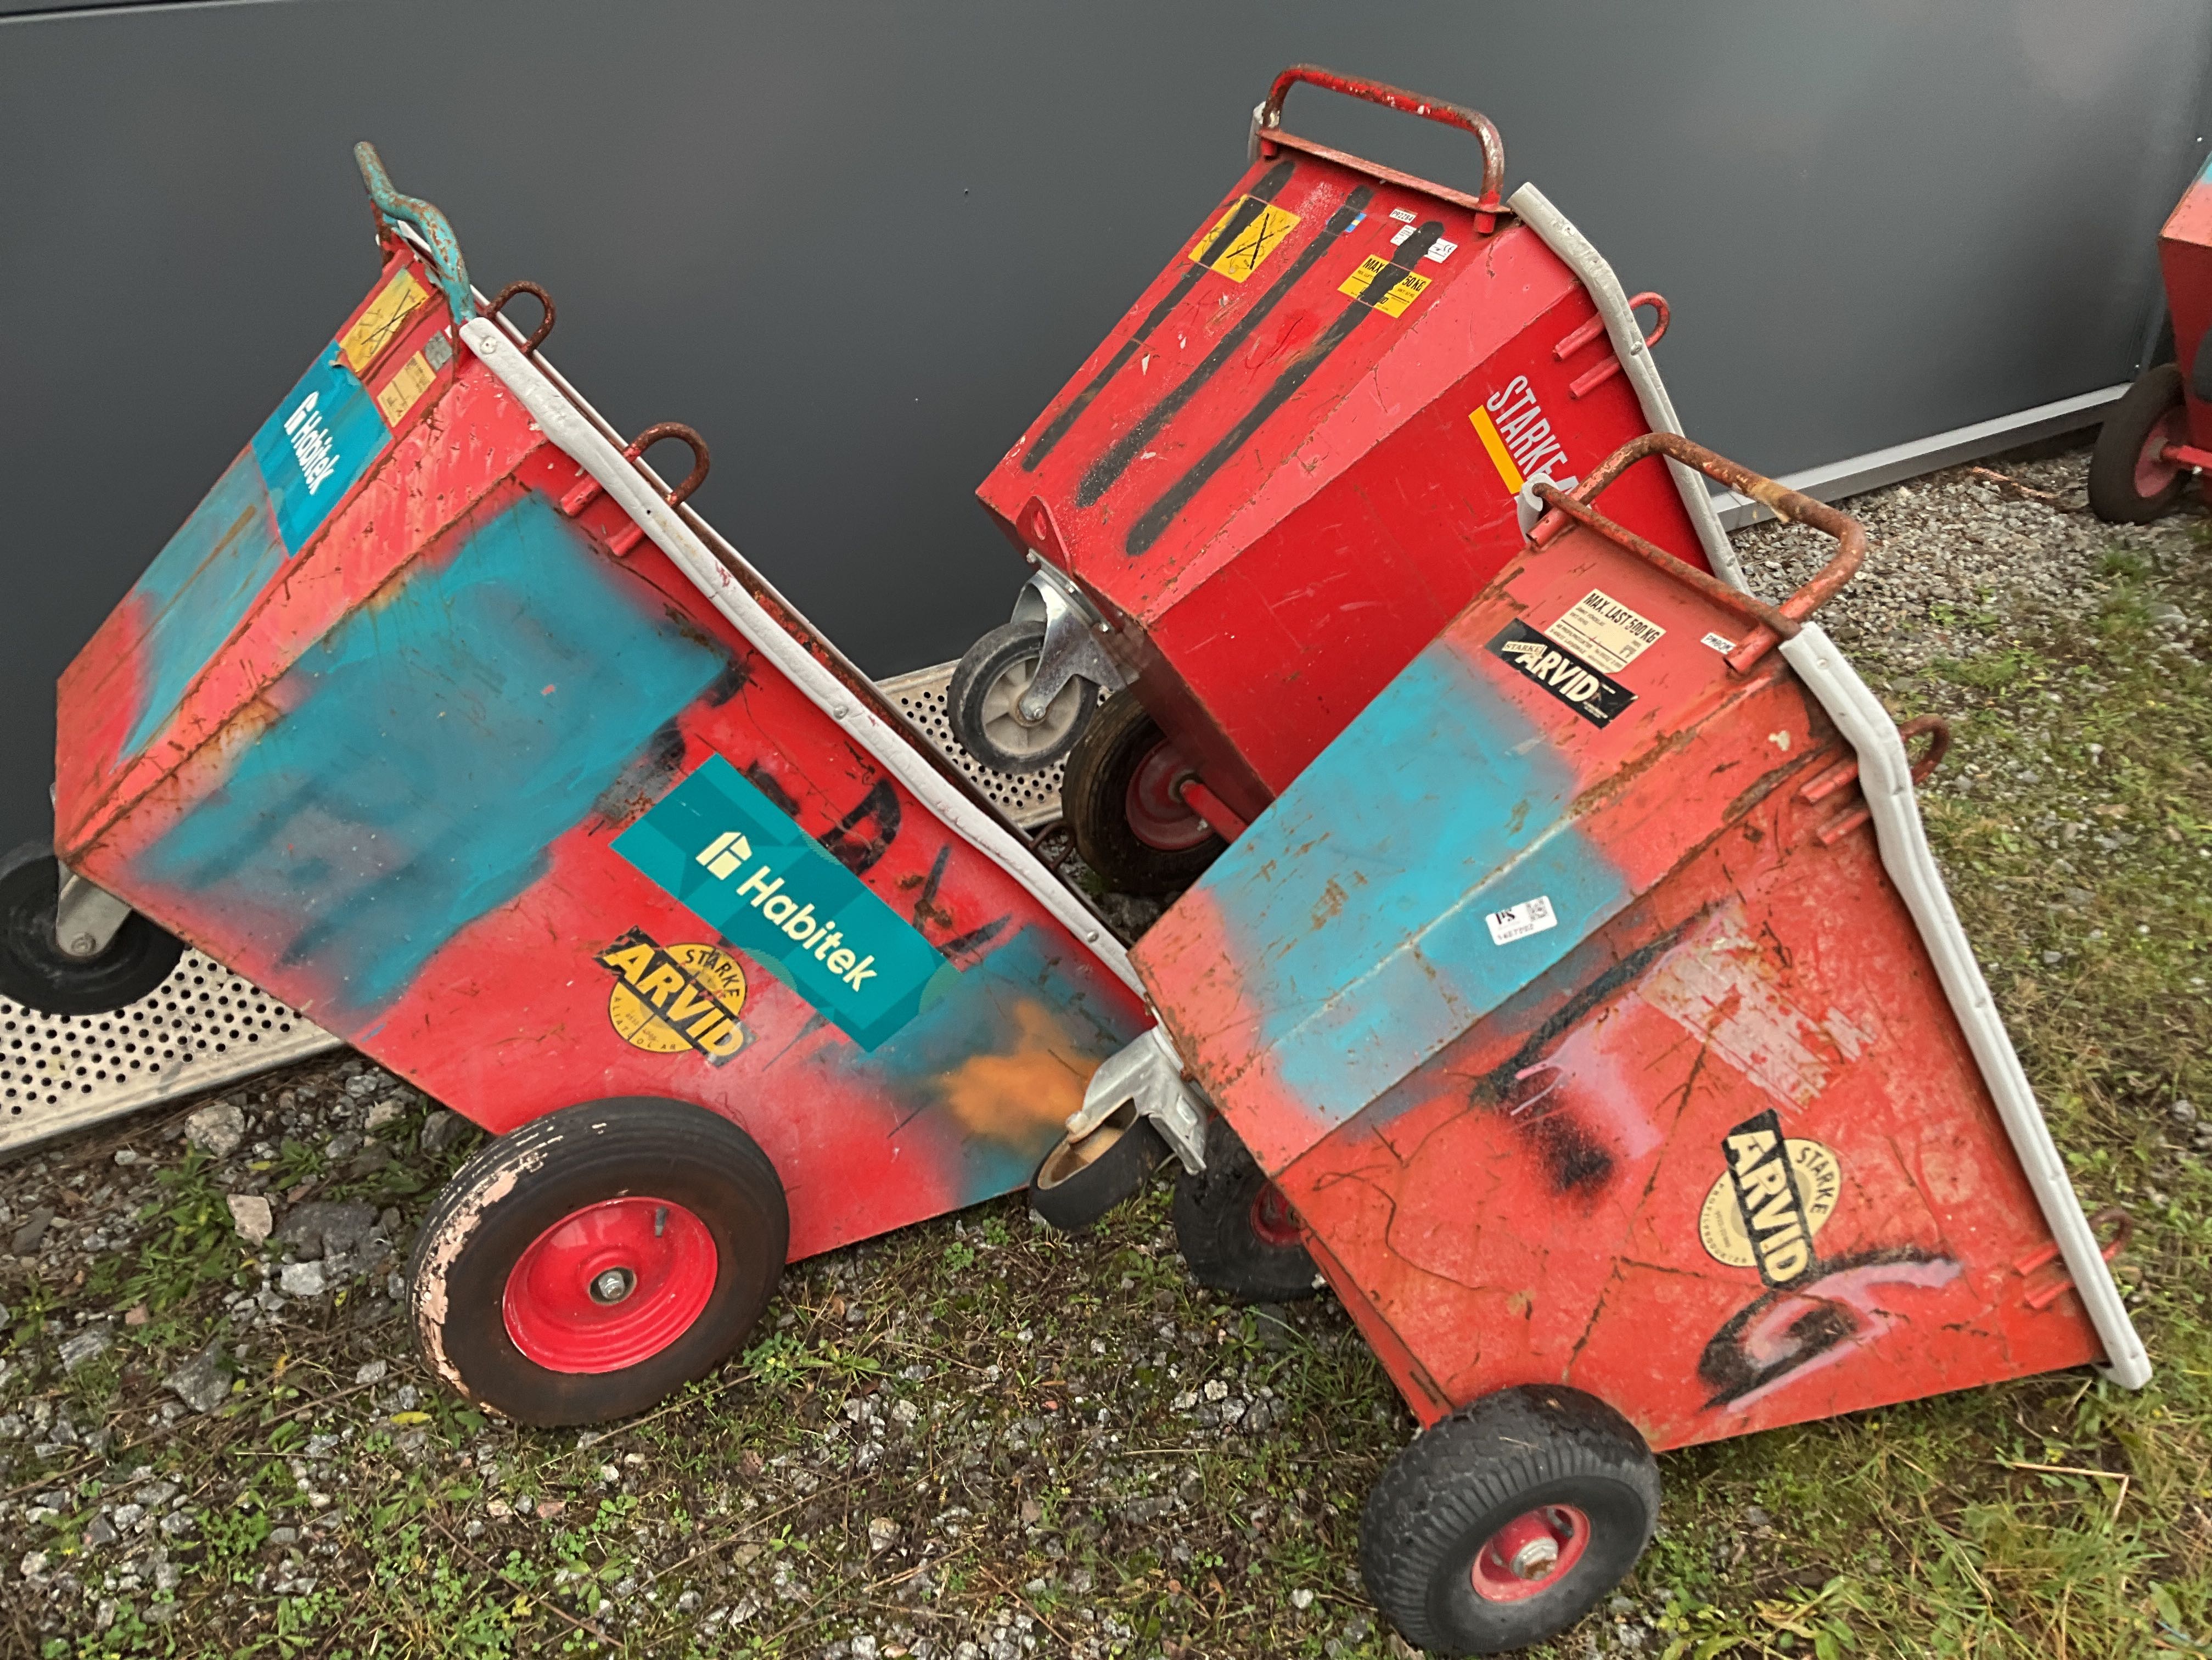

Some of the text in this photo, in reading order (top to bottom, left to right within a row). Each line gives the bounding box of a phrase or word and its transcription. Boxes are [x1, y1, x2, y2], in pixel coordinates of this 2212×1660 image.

[1412, 279, 1426, 292] KG
[291, 410, 340, 495] Habitek
[1504, 643, 1543, 654] STARKE
[1582, 592, 1610, 615] MAX.
[1604, 605, 1633, 627] LAST
[1624, 618, 1648, 637] 500
[1640, 627, 1660, 645] KG
[1515, 650, 1599, 703] ARVID
[736, 865, 877, 992] Habitek
[603, 943, 744, 1056] ARVID
[686, 949, 740, 998] STARKE
[1727, 1130, 1808, 1281] ARVID
[1796, 1146, 1835, 1214] STARKE
